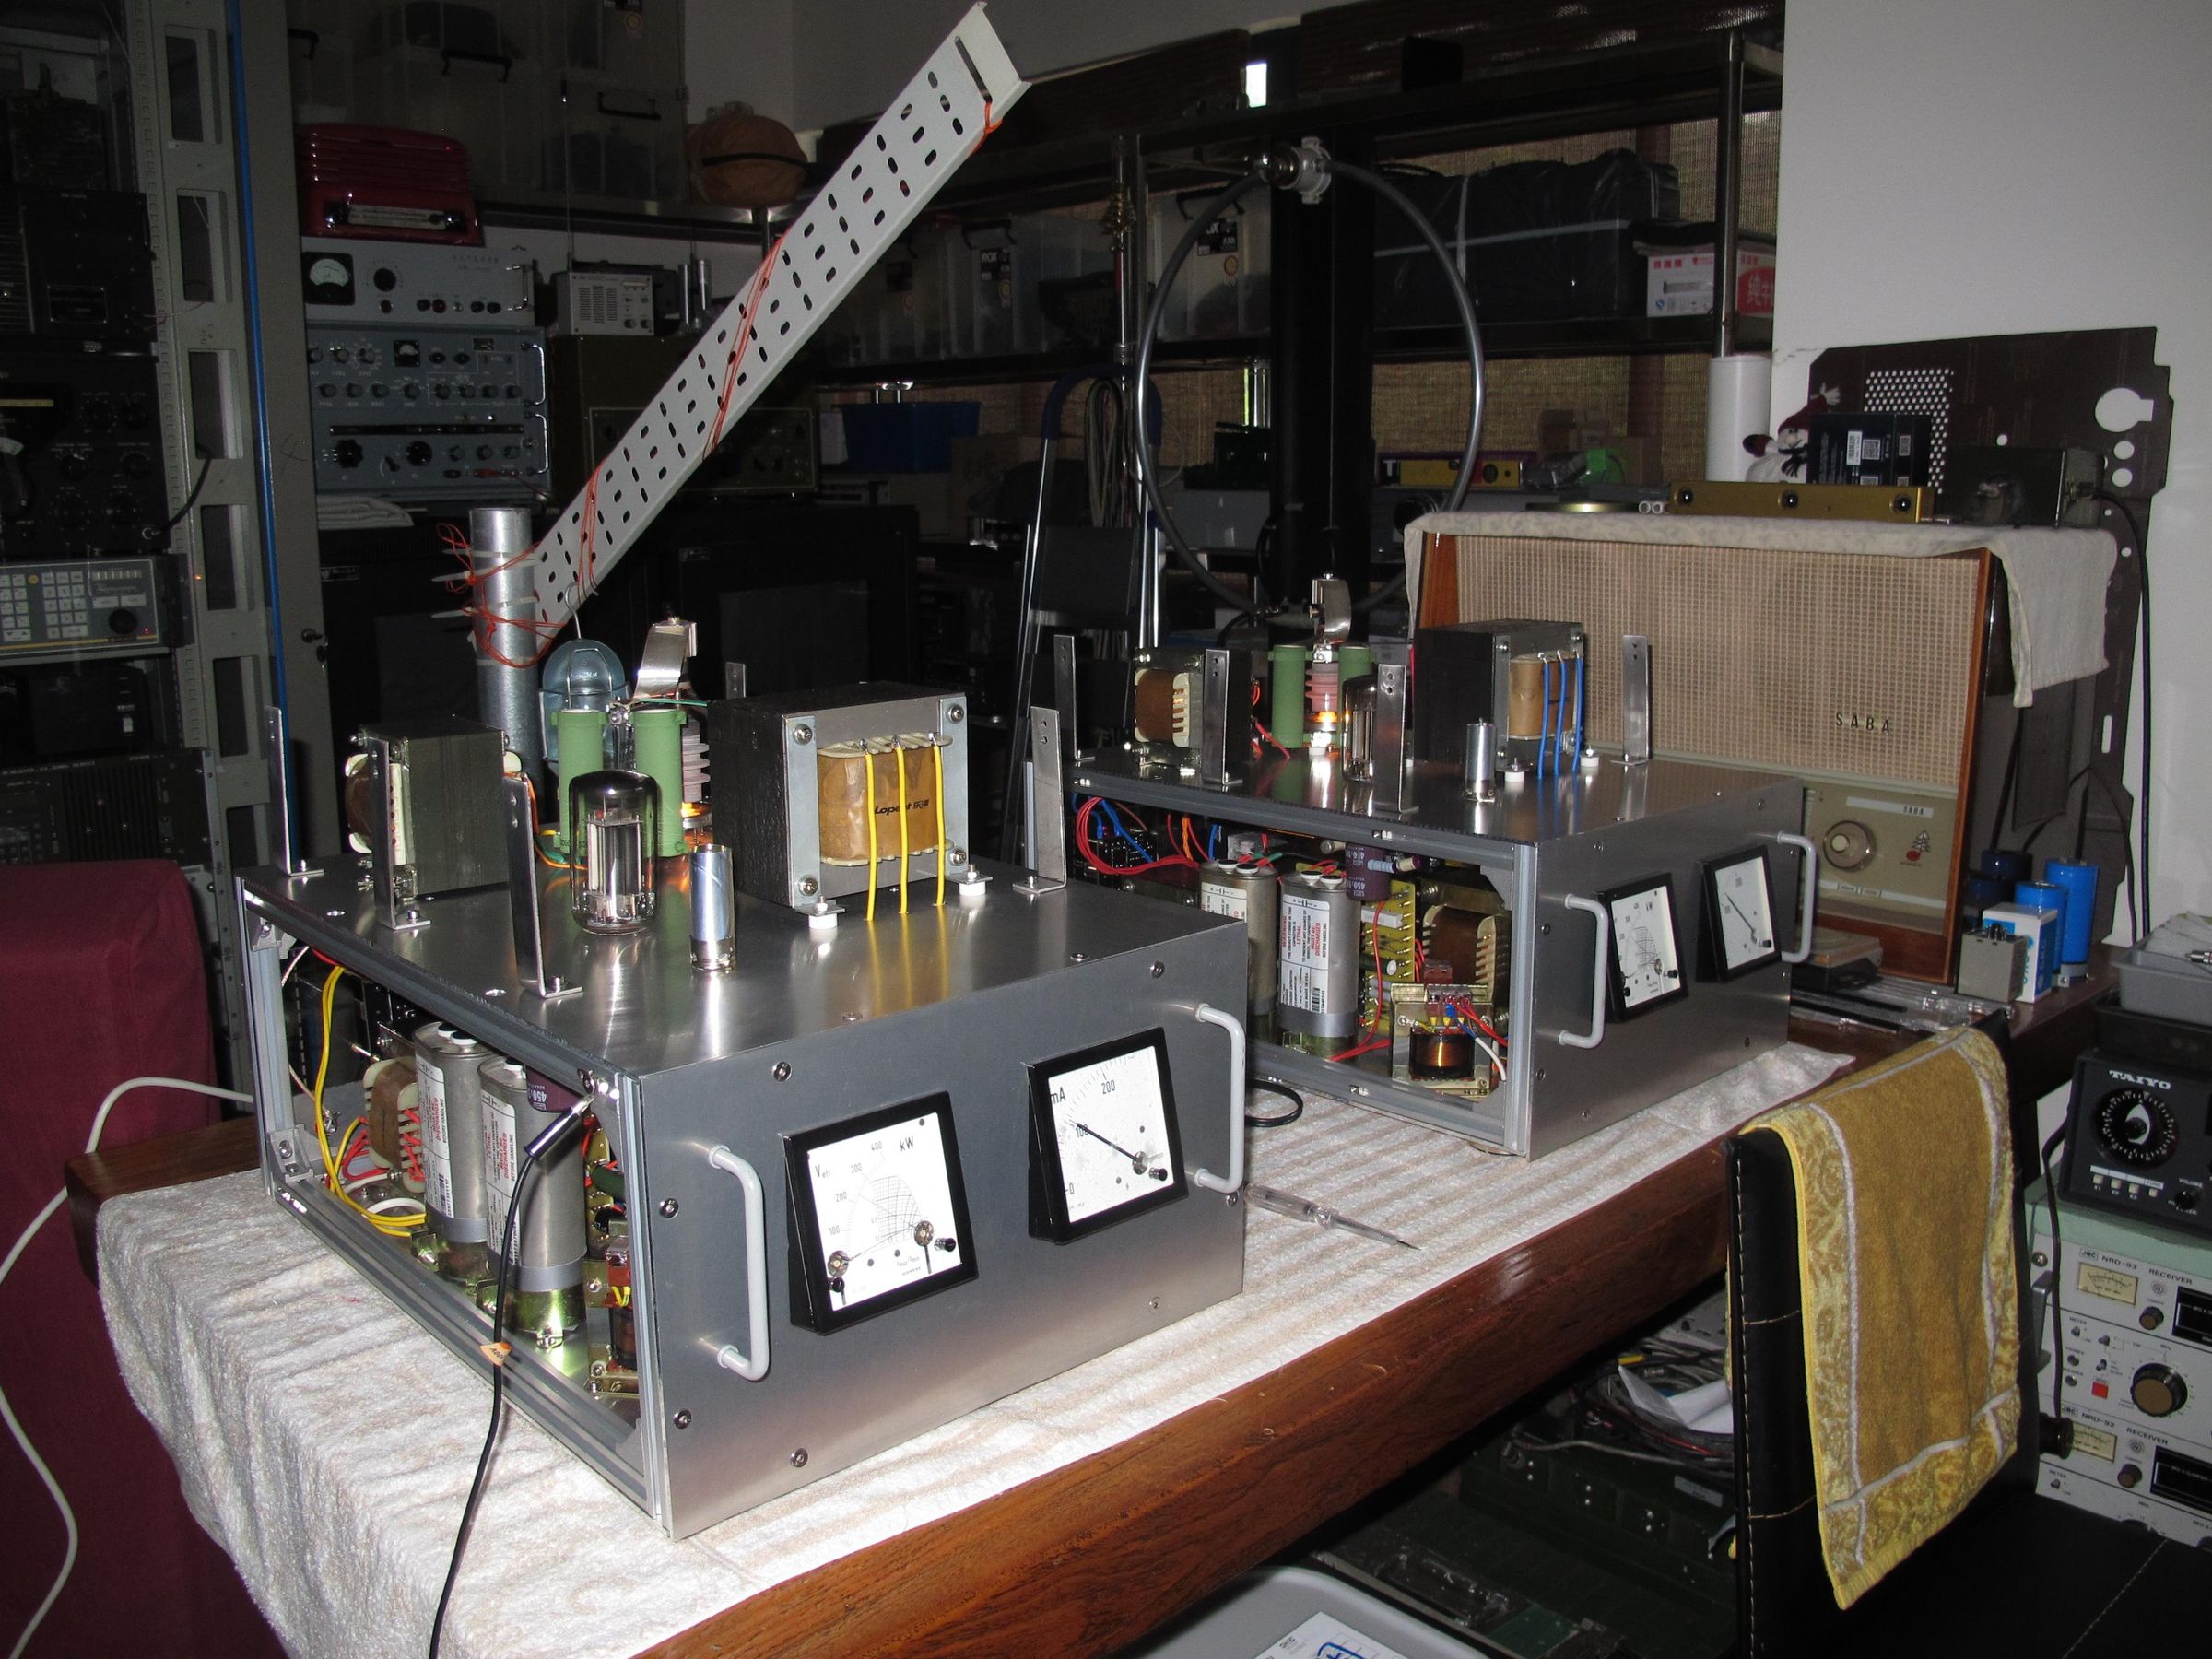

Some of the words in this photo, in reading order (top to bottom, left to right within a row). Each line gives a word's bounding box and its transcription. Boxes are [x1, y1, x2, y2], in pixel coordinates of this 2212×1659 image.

[1836, 713, 1890, 734] SABA
[875, 802, 912, 815] Lopet
[1903, 806, 1924, 815] SABA
[1101, 1079, 1116, 1095] 200
[2109, 1069, 2171, 1090] TAIYO
[1050, 1087, 1066, 1105] mA
[899, 1136, 914, 1151] kW
[851, 1163, 862, 1174] 300
[835, 1192, 847, 1202] 200
[829, 1225, 840, 1235] 100
[2081, 1250, 2096, 1259] JRC
[2102, 1256, 2137, 1270] NRD-93
[2149, 1268, 2193, 1285] RECEIVER
[2081, 1412, 2115, 1427] NRD-92
[2127, 1427, 2168, 1444] RECEIVER
